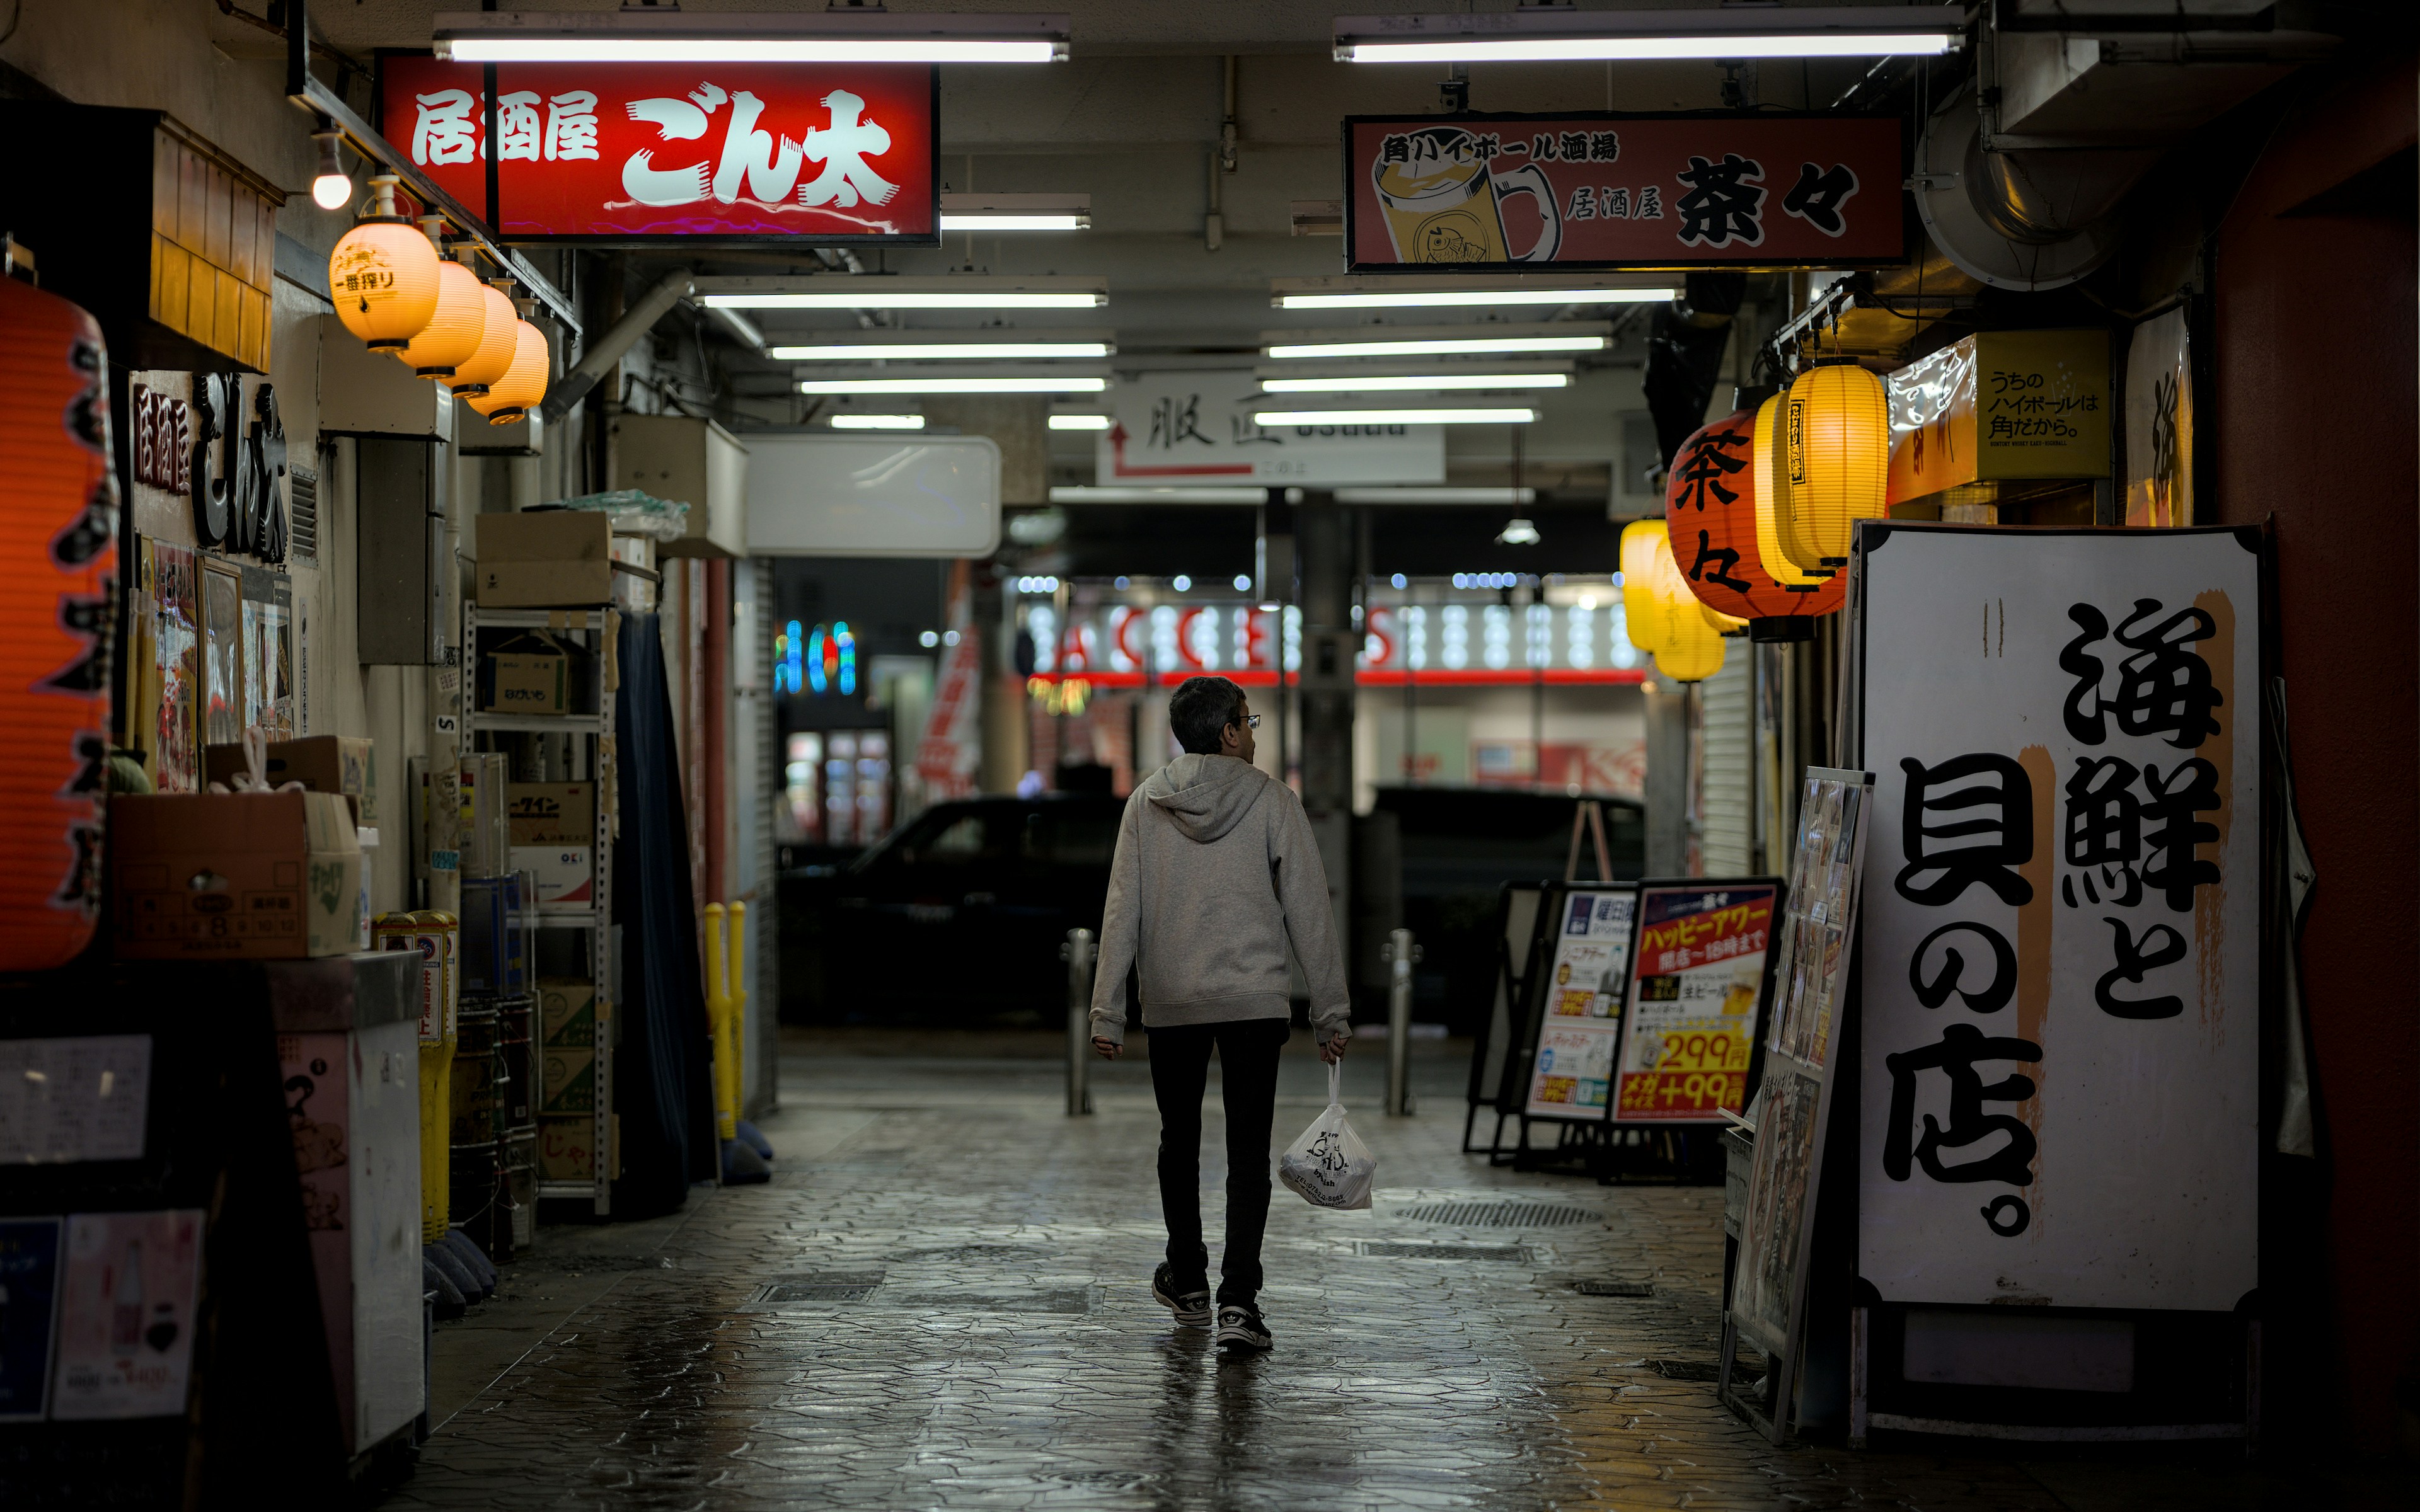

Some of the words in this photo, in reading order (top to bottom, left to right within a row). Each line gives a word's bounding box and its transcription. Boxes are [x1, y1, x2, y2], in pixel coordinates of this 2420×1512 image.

[412, 88, 599, 166] 居酒屋
[621, 80, 900, 208] ごん太
[1383, 131, 1621, 163] 角ハイボール酒場
[1565, 185, 1665, 221] 居酒屋
[1676, 153, 1862, 249] 茶々
[335, 271, 394, 292] 一番搾り
[1988, 394, 2099, 415] ハイボールは
[1991, 371, 2044, 394] うちの
[1988, 415, 2078, 439] 角だから。
[1674, 428, 1751, 593] 茶々
[2058, 596, 2223, 1021] 海鮮と
[1641, 905, 1770, 953] ハッピーアワー
[1882, 752, 2043, 1238] 貝の店。
